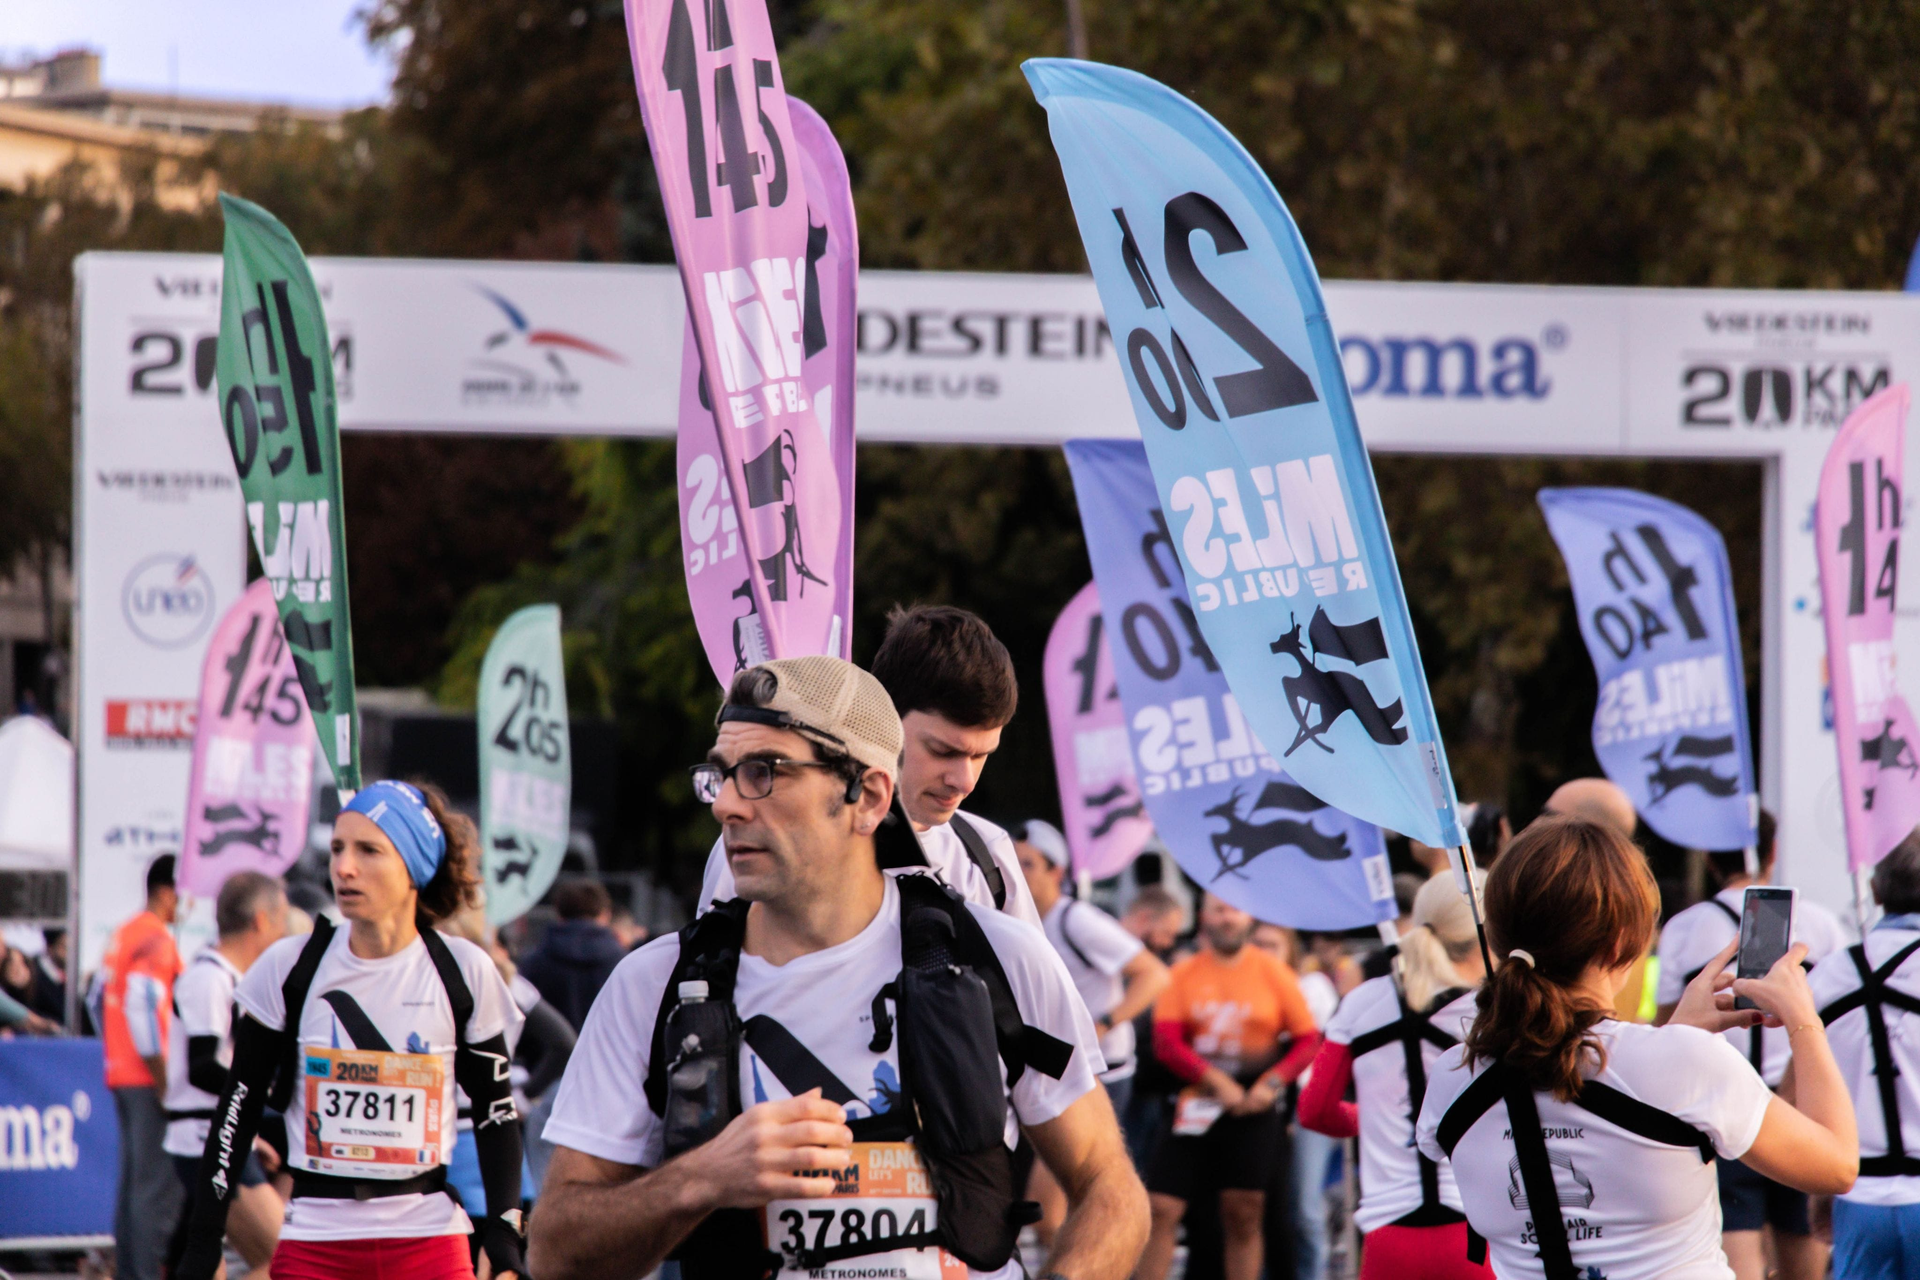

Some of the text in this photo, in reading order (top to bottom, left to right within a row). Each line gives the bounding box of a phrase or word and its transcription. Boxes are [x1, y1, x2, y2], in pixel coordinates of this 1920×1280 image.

[325, 1088, 415, 1122] 37811
[340, 1127, 402, 1138] METRONOMES
[1542, 1128, 1585, 1139] EPUBLIC
[869, 1148, 926, 1170] DANC
[906, 1171, 934, 1195] RU
[779, 1208, 926, 1252] 37804
[1576, 1226, 1603, 1241] LIFE
[809, 1267, 907, 1280] METRONOMES
